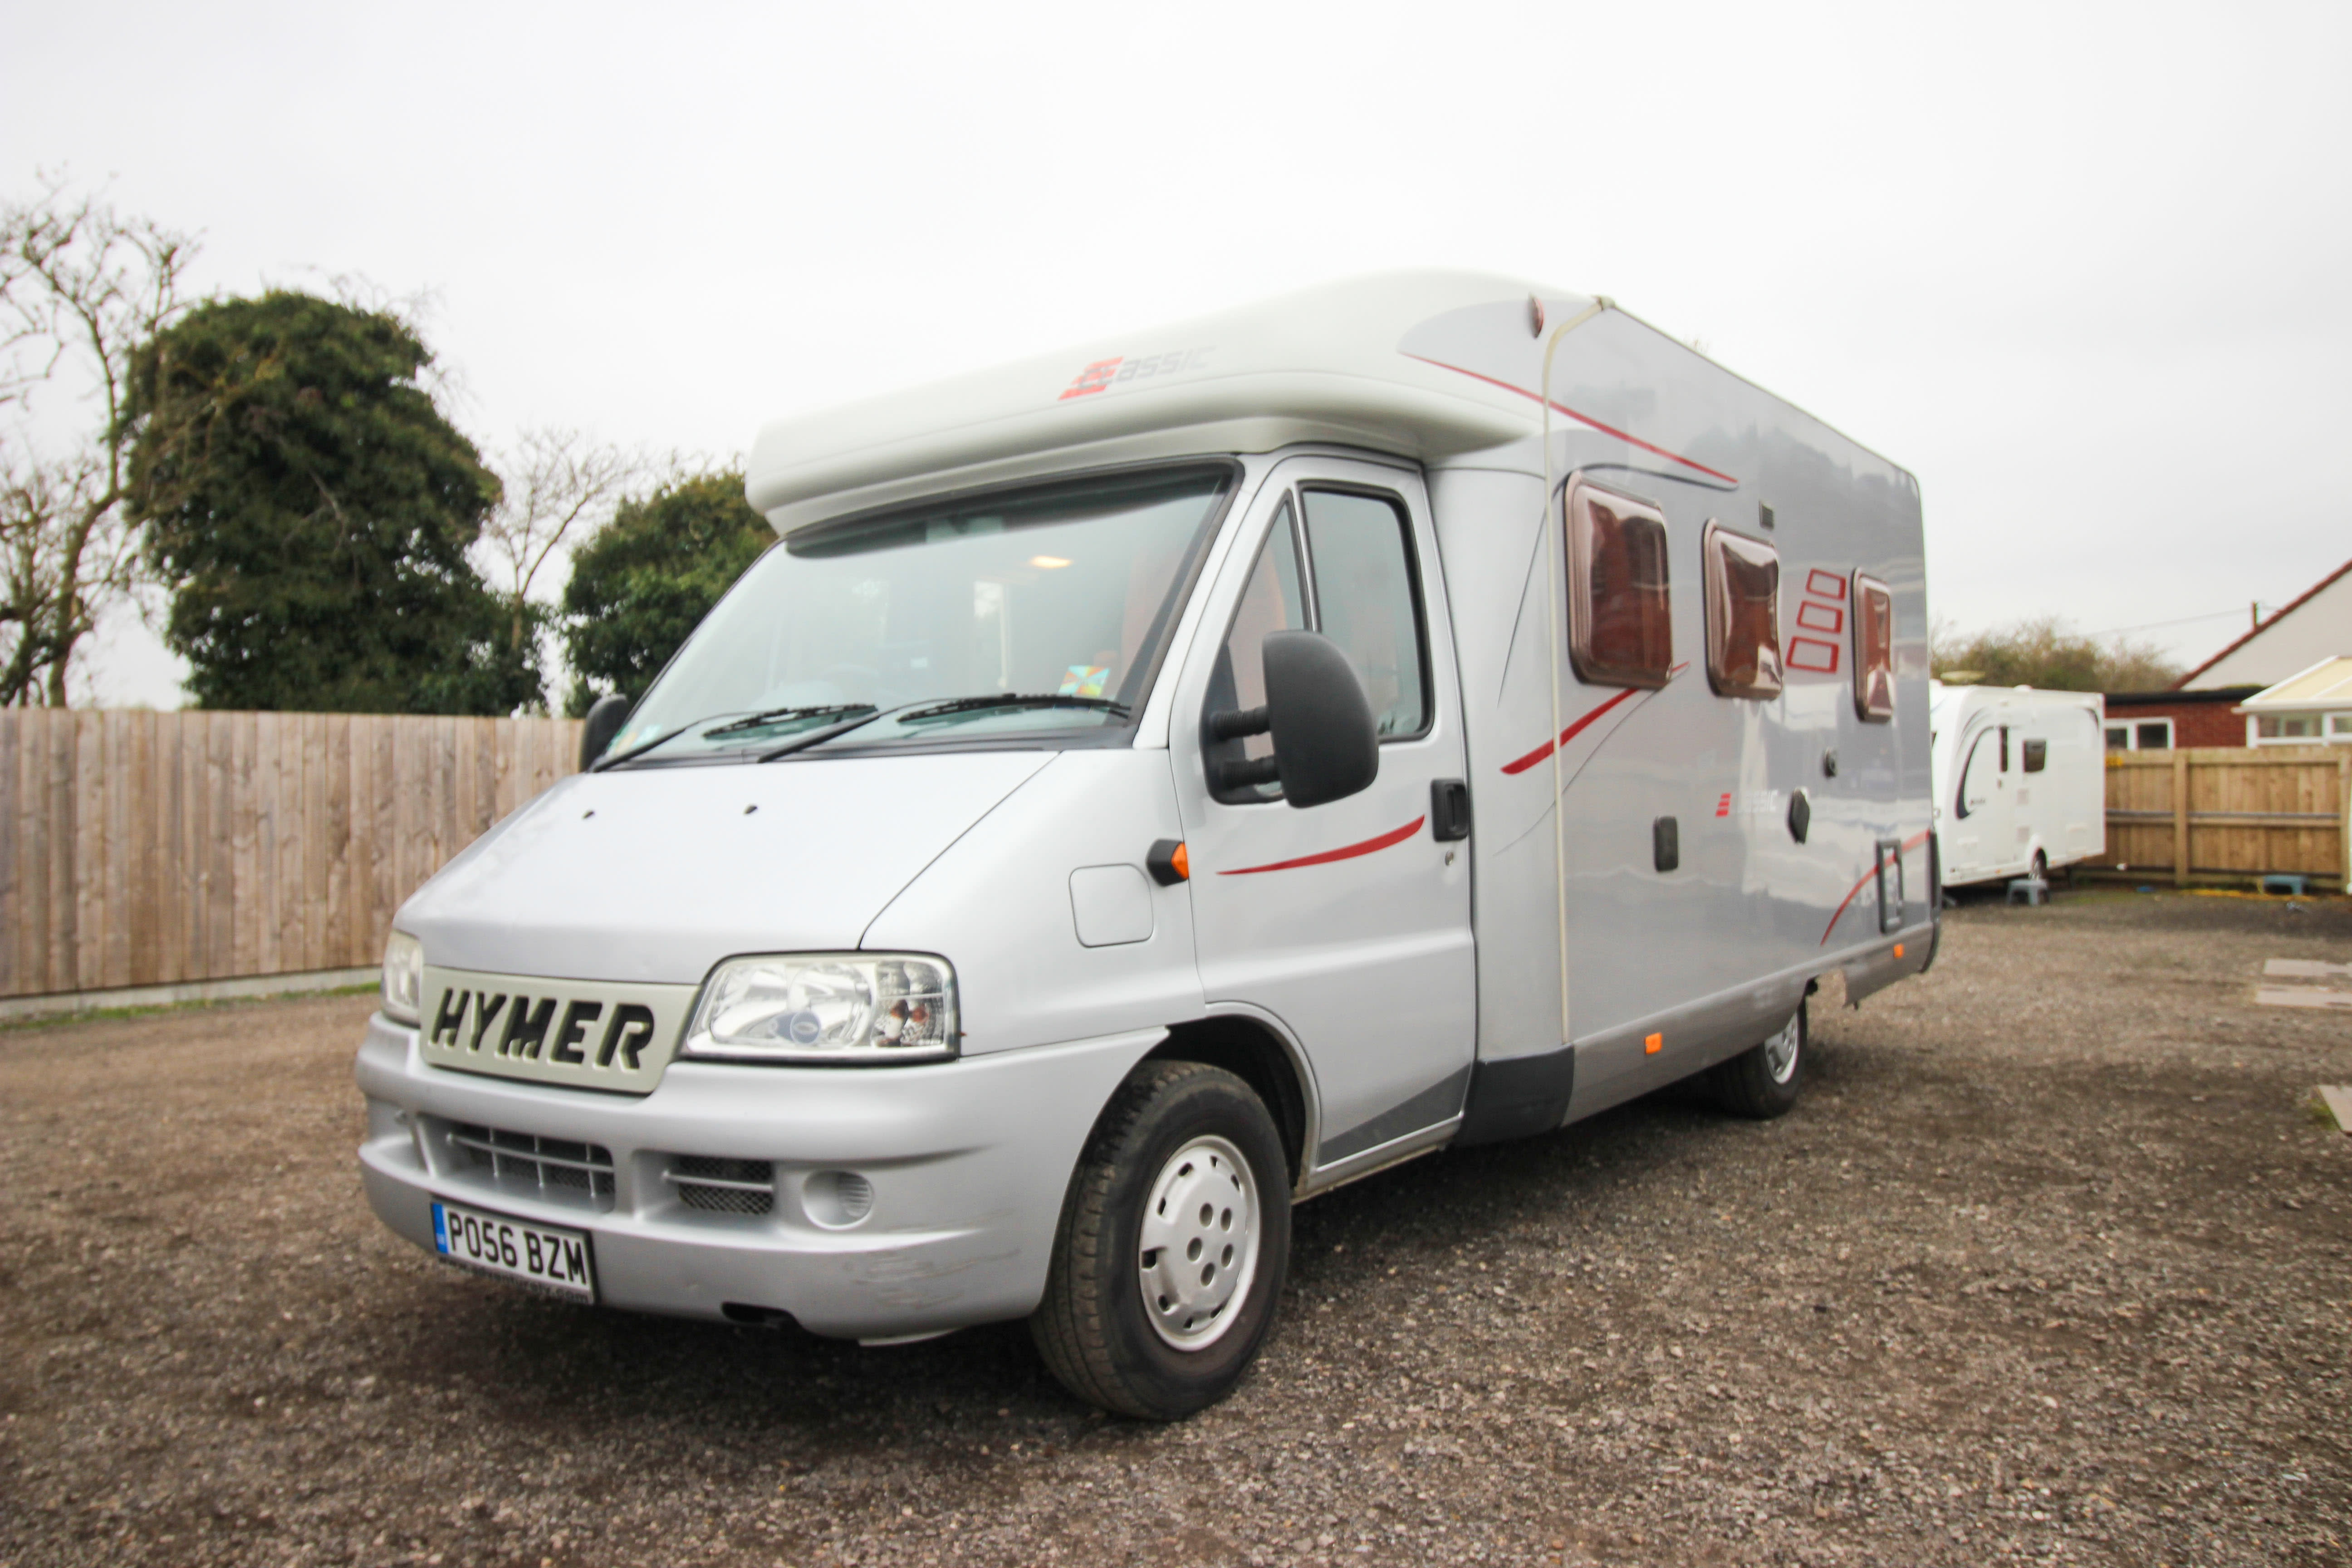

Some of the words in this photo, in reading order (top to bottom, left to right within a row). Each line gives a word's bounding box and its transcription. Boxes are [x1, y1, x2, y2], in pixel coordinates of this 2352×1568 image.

[430, 987, 655, 1070] HYMER
[448, 1212, 517, 1267] PO56
[523, 1230, 587, 1284] BZM
